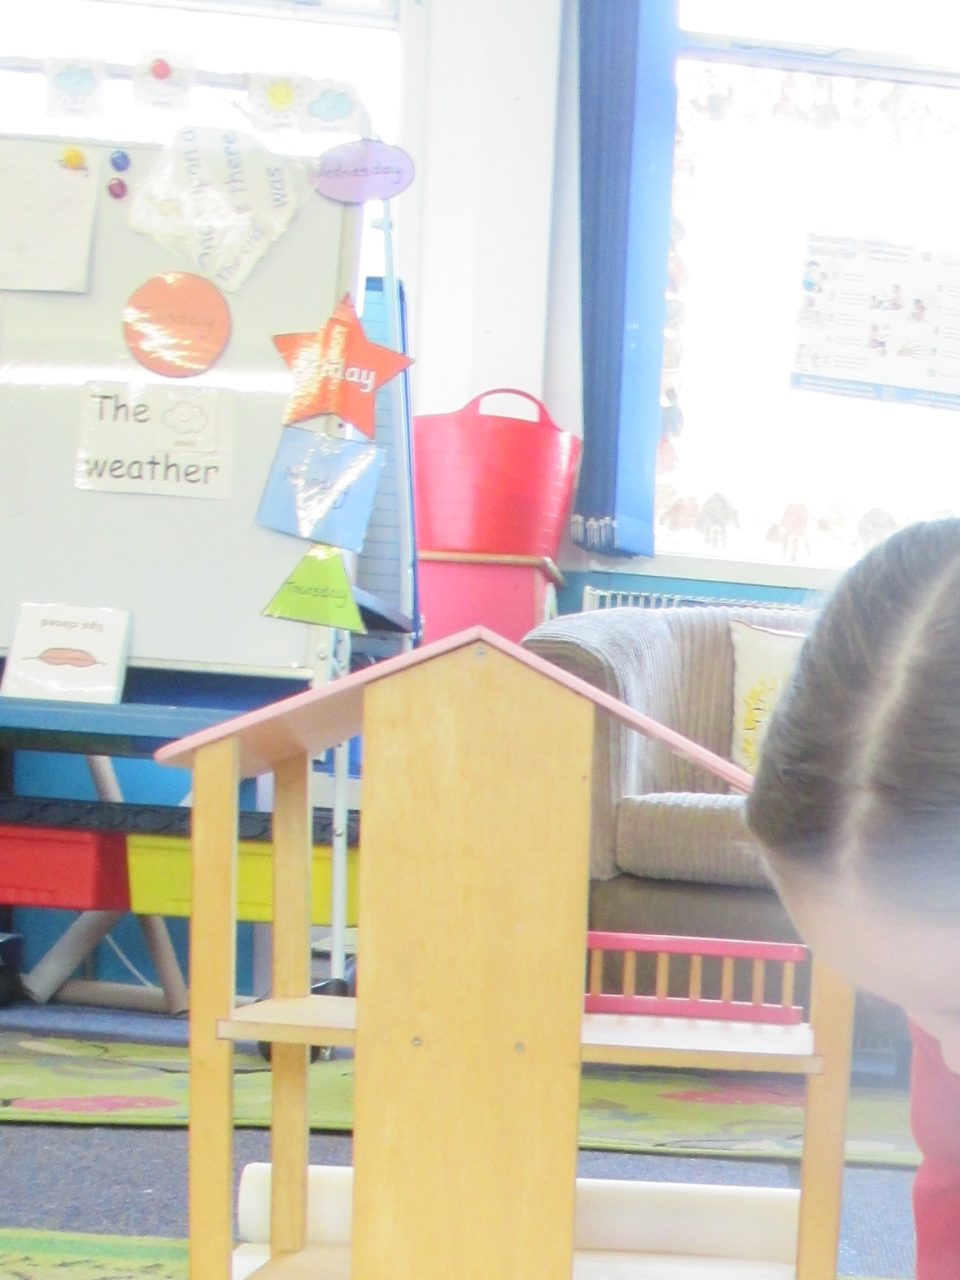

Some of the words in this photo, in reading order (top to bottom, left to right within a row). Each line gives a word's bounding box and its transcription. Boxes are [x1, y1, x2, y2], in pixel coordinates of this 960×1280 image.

[179, 128, 196, 143] a
[221, 132, 249, 194] there
[264, 167, 289, 209] was
[91, 392, 151, 424] The
[83, 453, 220, 486] weather
